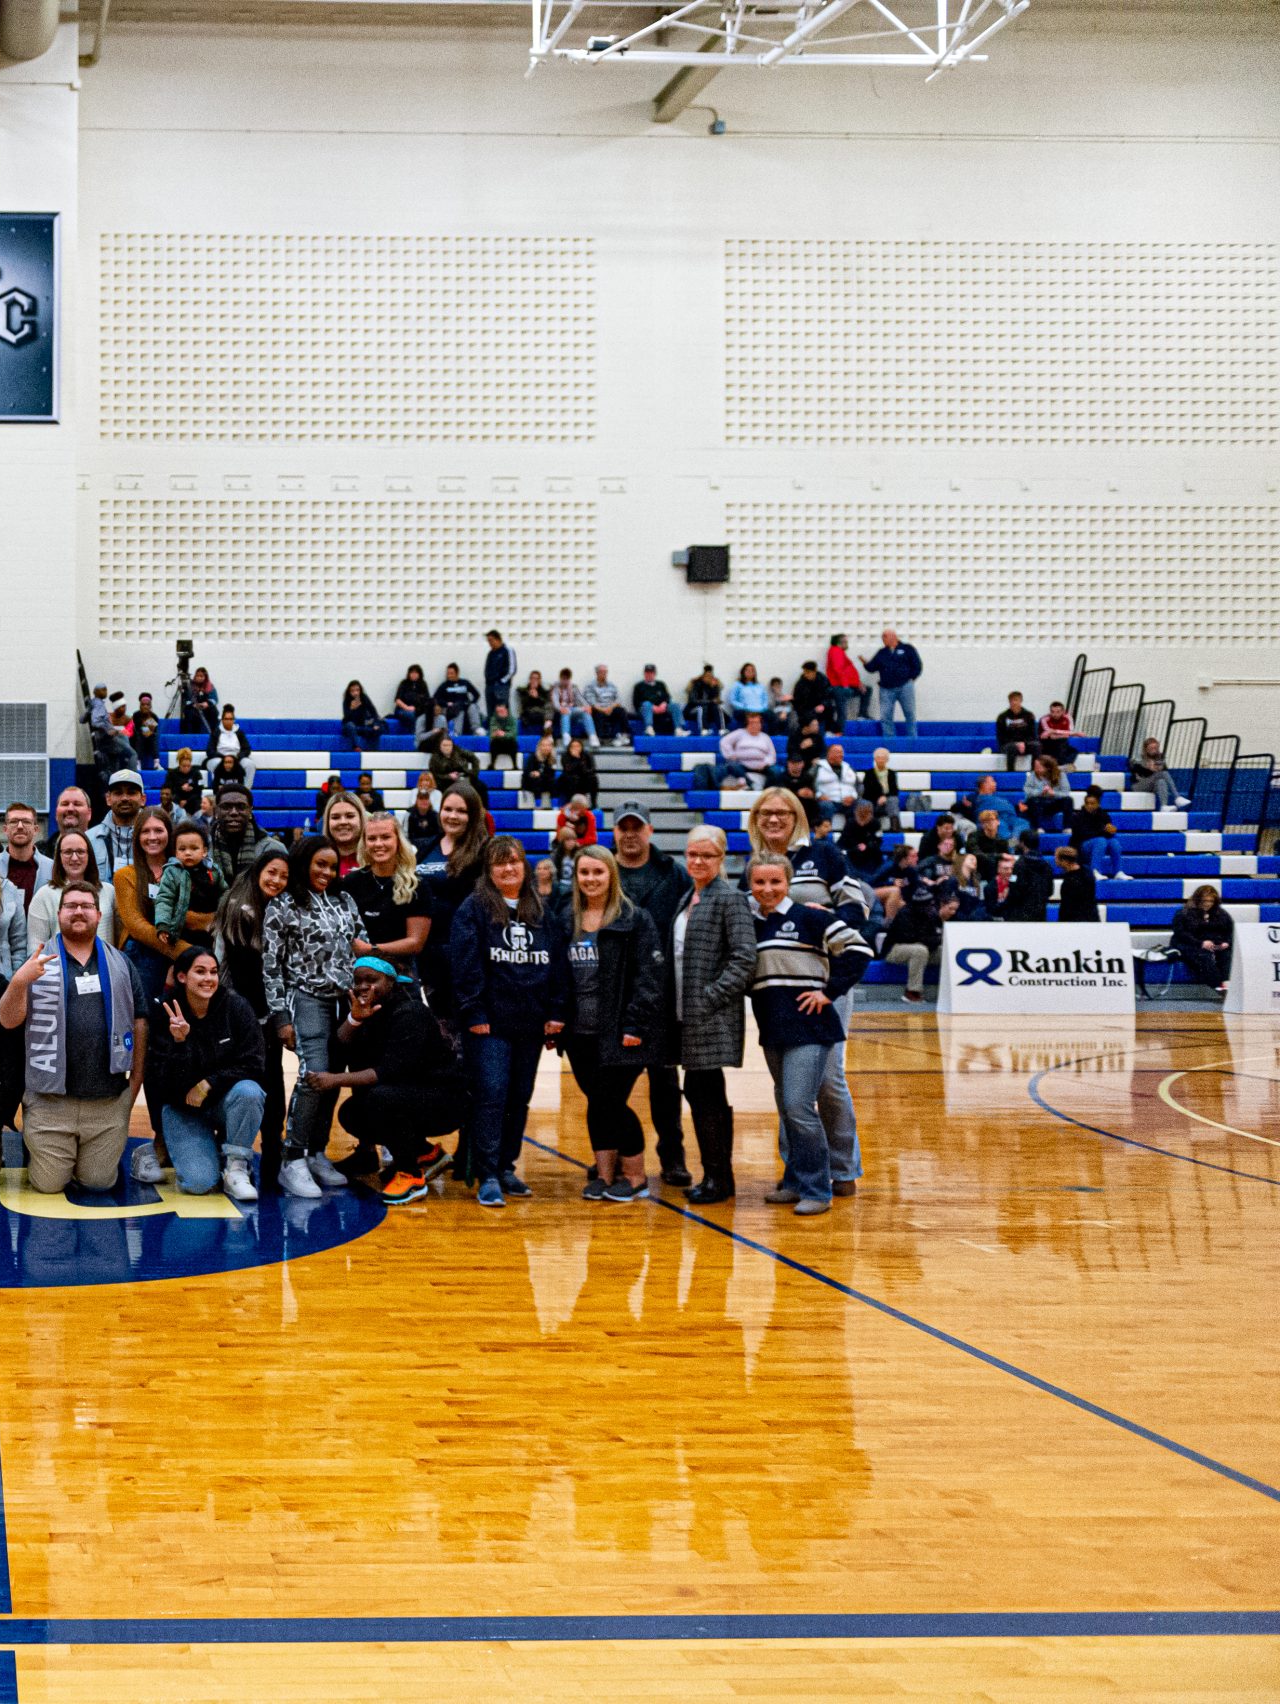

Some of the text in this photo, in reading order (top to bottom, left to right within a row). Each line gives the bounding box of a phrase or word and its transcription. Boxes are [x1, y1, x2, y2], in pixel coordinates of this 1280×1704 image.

[489, 947, 550, 965] KNIGHTS
[1006, 949, 1127, 973] Rankin
[1008, 975, 1128, 987] Construction Inc.
